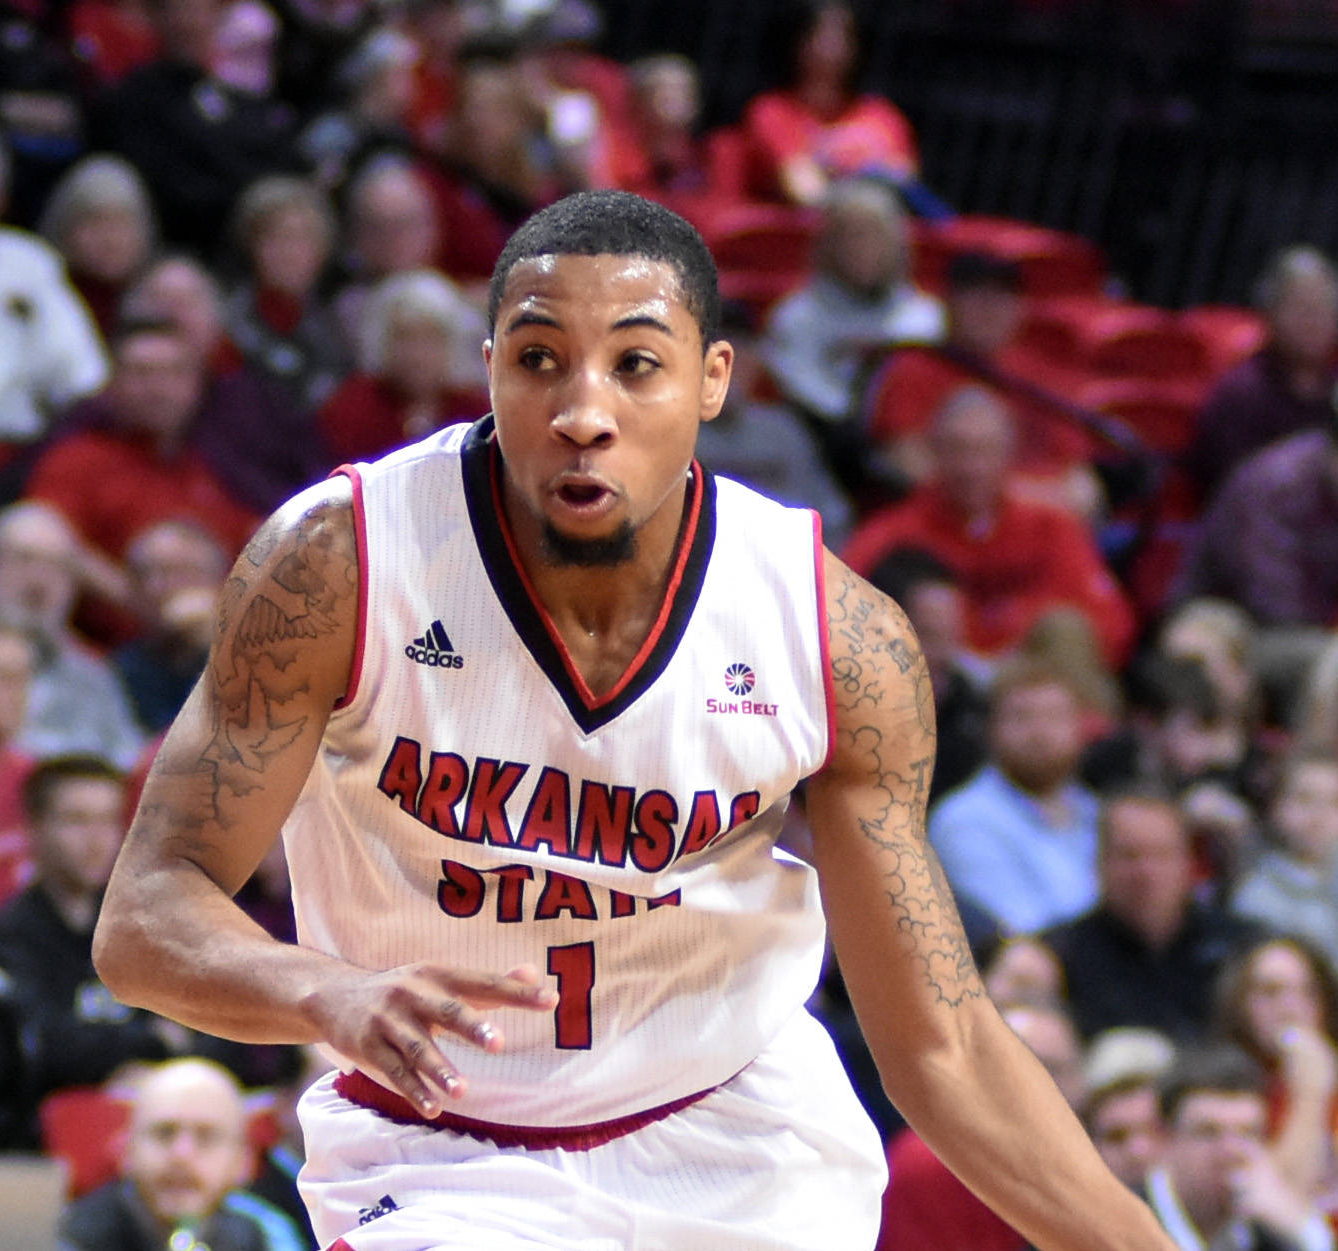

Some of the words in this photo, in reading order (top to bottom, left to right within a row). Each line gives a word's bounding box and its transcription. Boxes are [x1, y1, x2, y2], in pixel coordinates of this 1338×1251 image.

[404, 645, 465, 669] addas
[706, 698, 738, 714] SUN
[741, 699, 779, 717] BELT
[437, 859, 681, 923] STA
[546, 940, 596, 1051] 1
